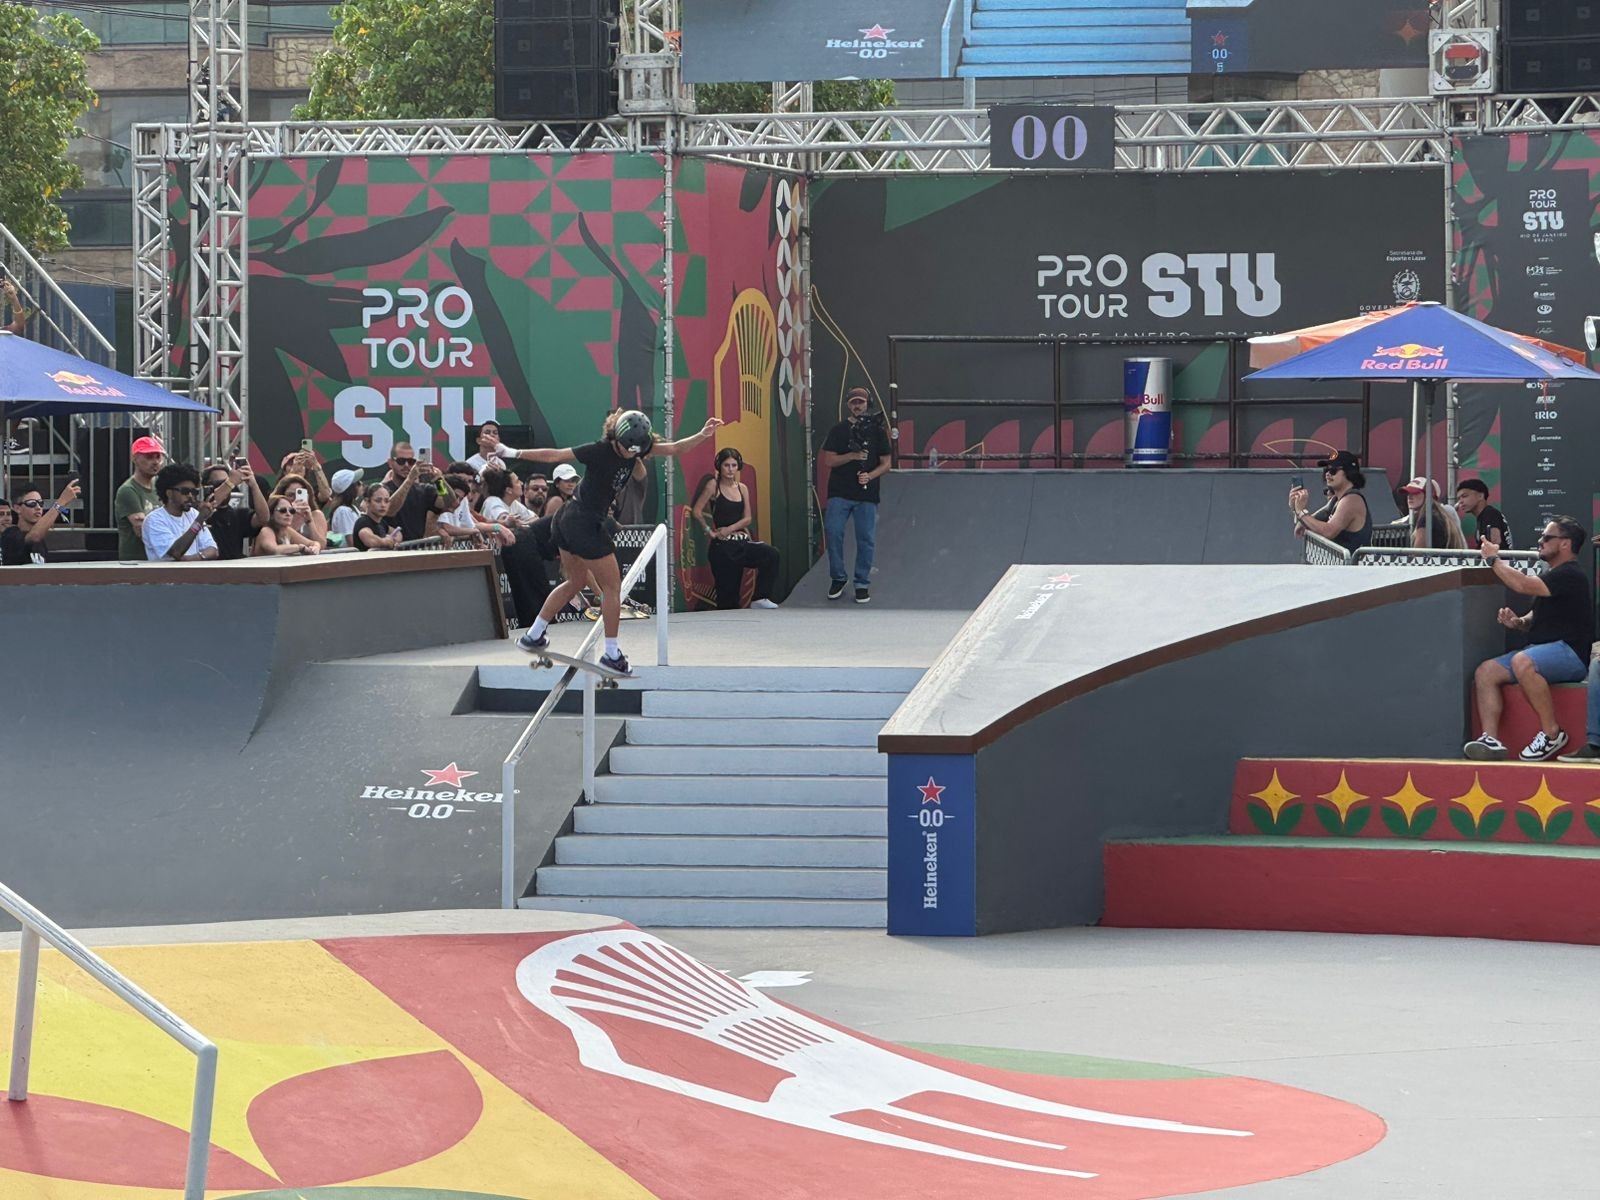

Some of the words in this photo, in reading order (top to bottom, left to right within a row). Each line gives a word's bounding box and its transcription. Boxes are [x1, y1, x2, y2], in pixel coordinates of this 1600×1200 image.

[825, 39, 924, 48] Heineken
[1011, 114, 1088, 160] 00
[1529, 188, 1557, 200] PRO
[1529, 200, 1557, 208] TOUR
[1522, 210, 1564, 231] STU
[1037, 253, 1129, 288] PRO
[1141, 252, 1282, 318] STU
[362, 286, 474, 329] PRO
[1037, 293, 1129, 319] TOUR
[362, 337, 474, 369] TOUR
[1361, 359, 1405, 370] Red
[1406, 358, 1449, 370] Bull
[1143, 394, 1164, 405] Bull
[407, 803, 454, 819] 0.0
[919, 808, 944, 828] 0.0
[922, 831, 938, 909] Heineken
